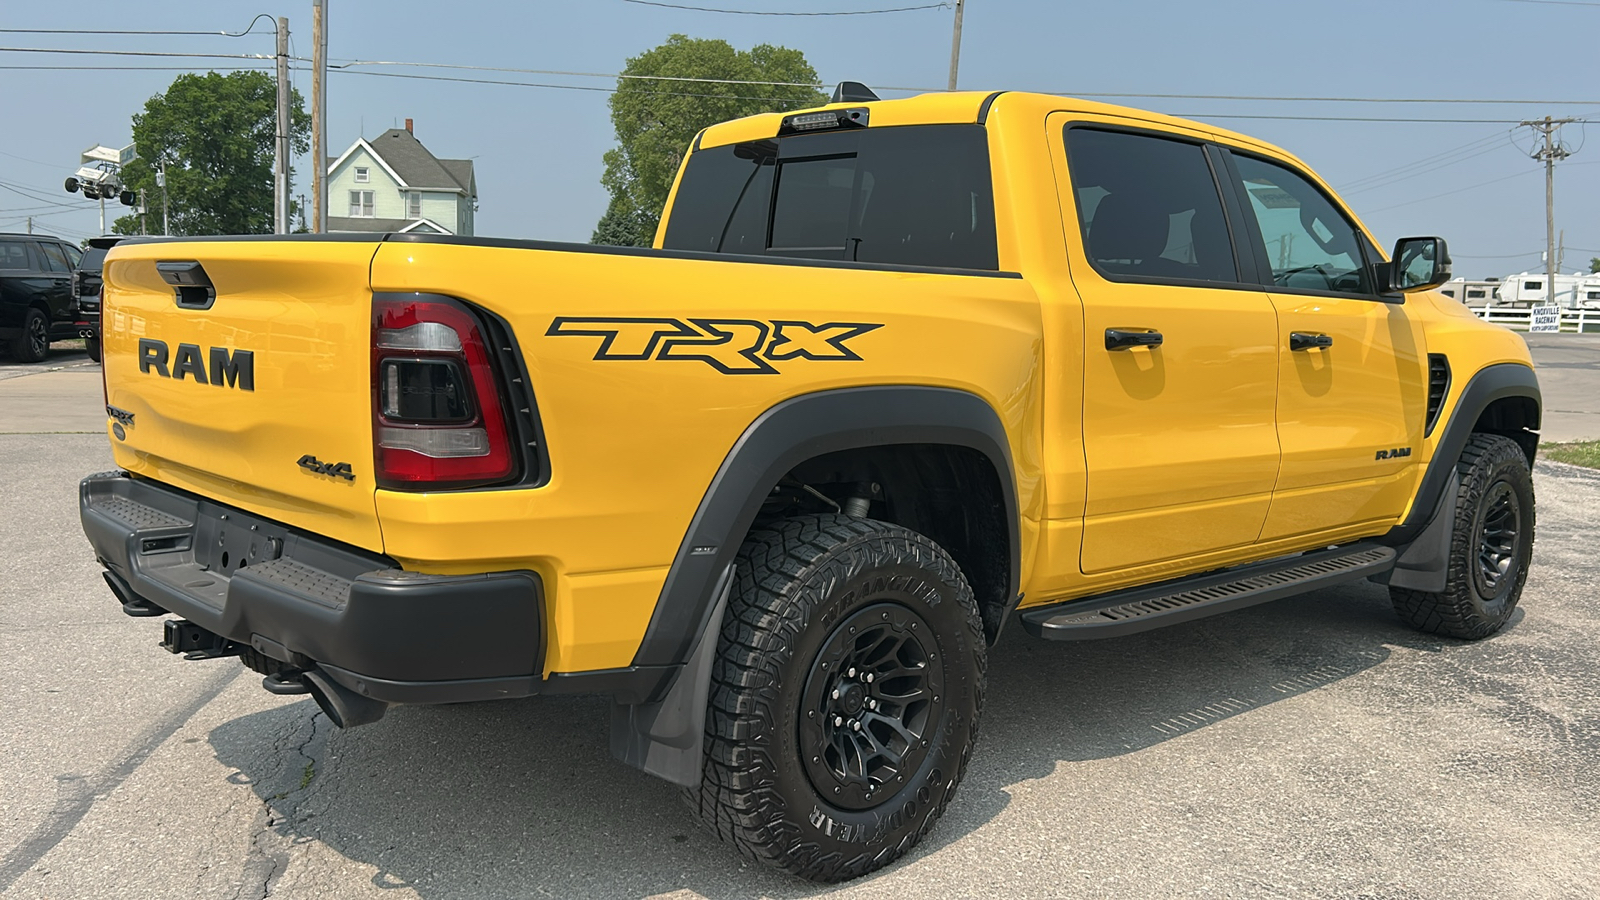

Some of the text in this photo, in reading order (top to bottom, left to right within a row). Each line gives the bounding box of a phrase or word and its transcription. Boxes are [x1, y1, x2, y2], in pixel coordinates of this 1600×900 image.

[1533, 306, 1560, 316] KNOXVILLE
[1535, 316, 1557, 325] RACEWAY
[545, 316, 885, 375] TRX
[138, 337, 254, 392] RAM
[1375, 447, 1412, 461] RAM
